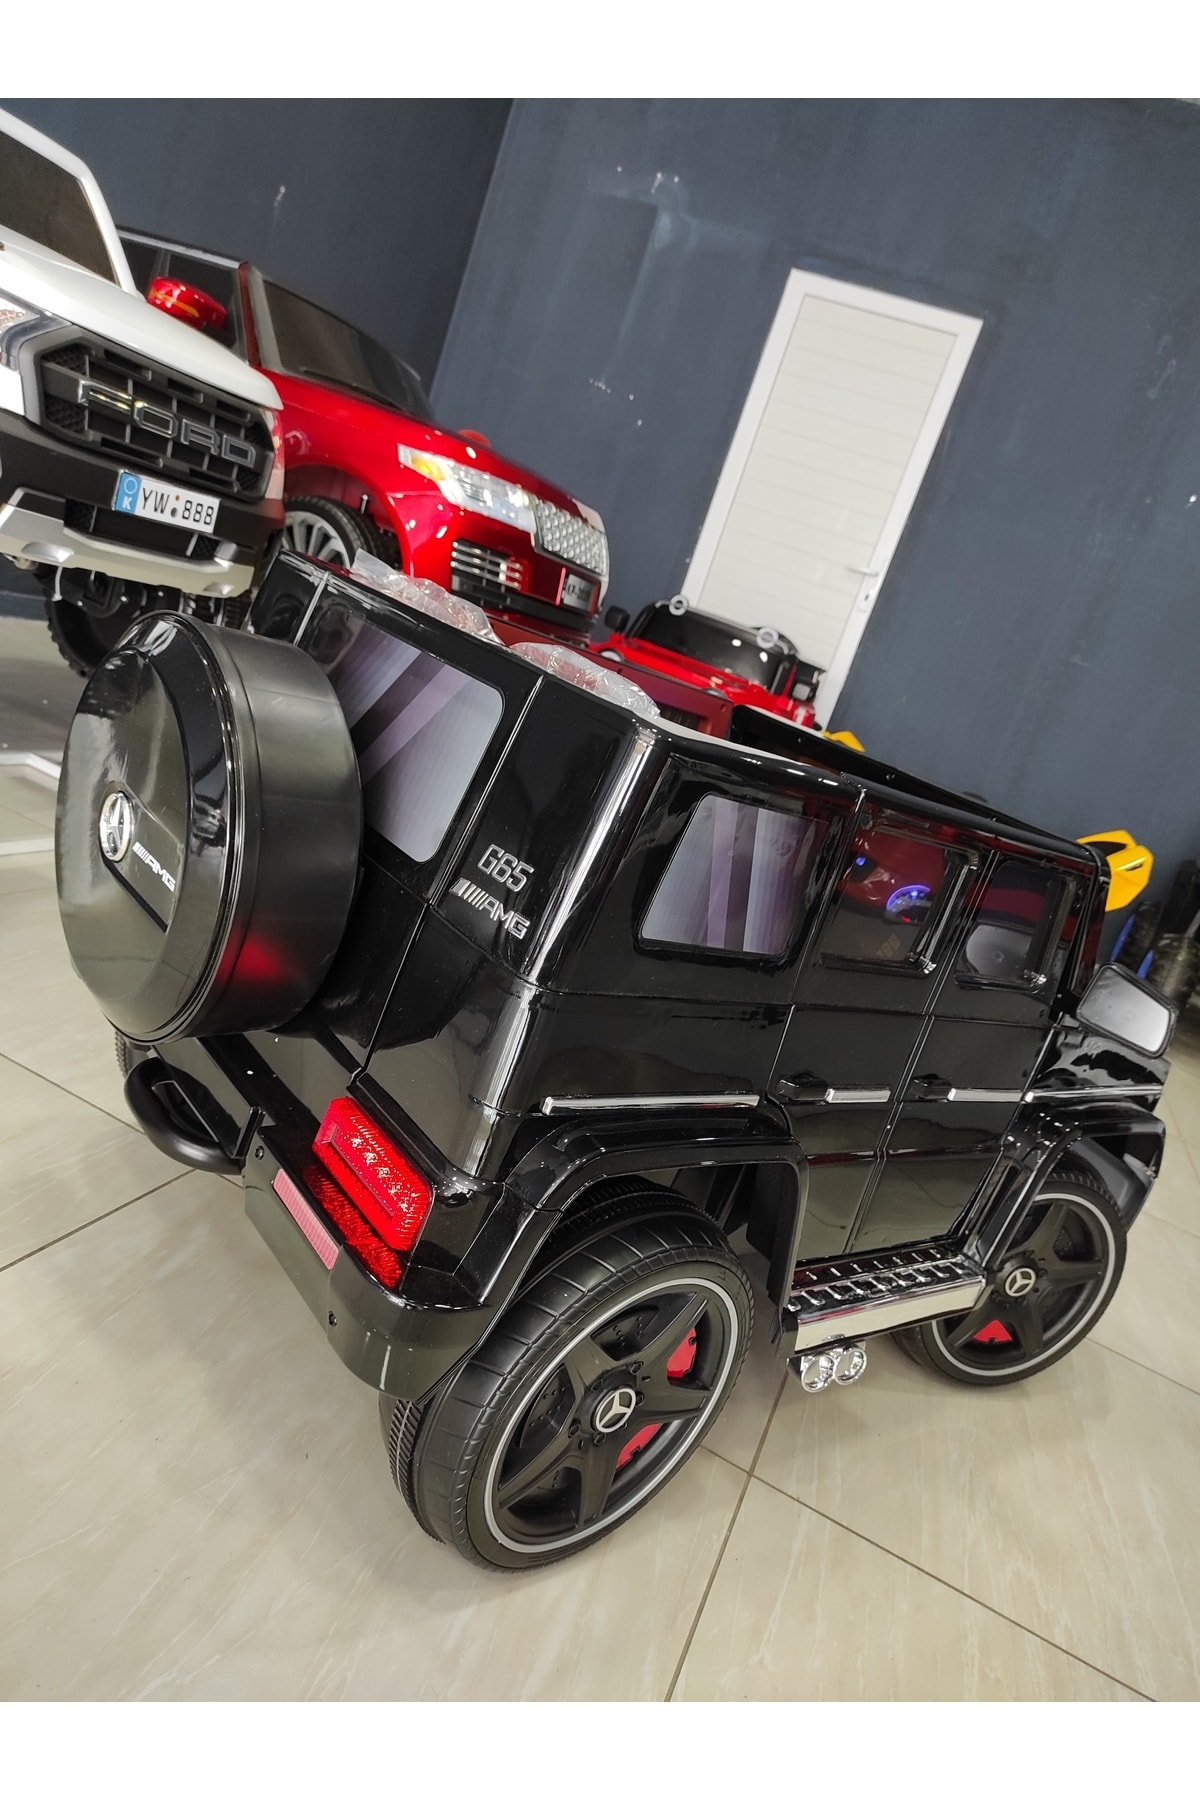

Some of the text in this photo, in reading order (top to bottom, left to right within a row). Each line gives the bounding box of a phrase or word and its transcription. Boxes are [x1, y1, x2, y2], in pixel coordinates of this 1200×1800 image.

[78, 379, 256, 468] FORD
[122, 496, 132, 510] K
[144, 855, 176, 892] AMG
[478, 844, 535, 892] G65
[479, 895, 531, 940] AMG
